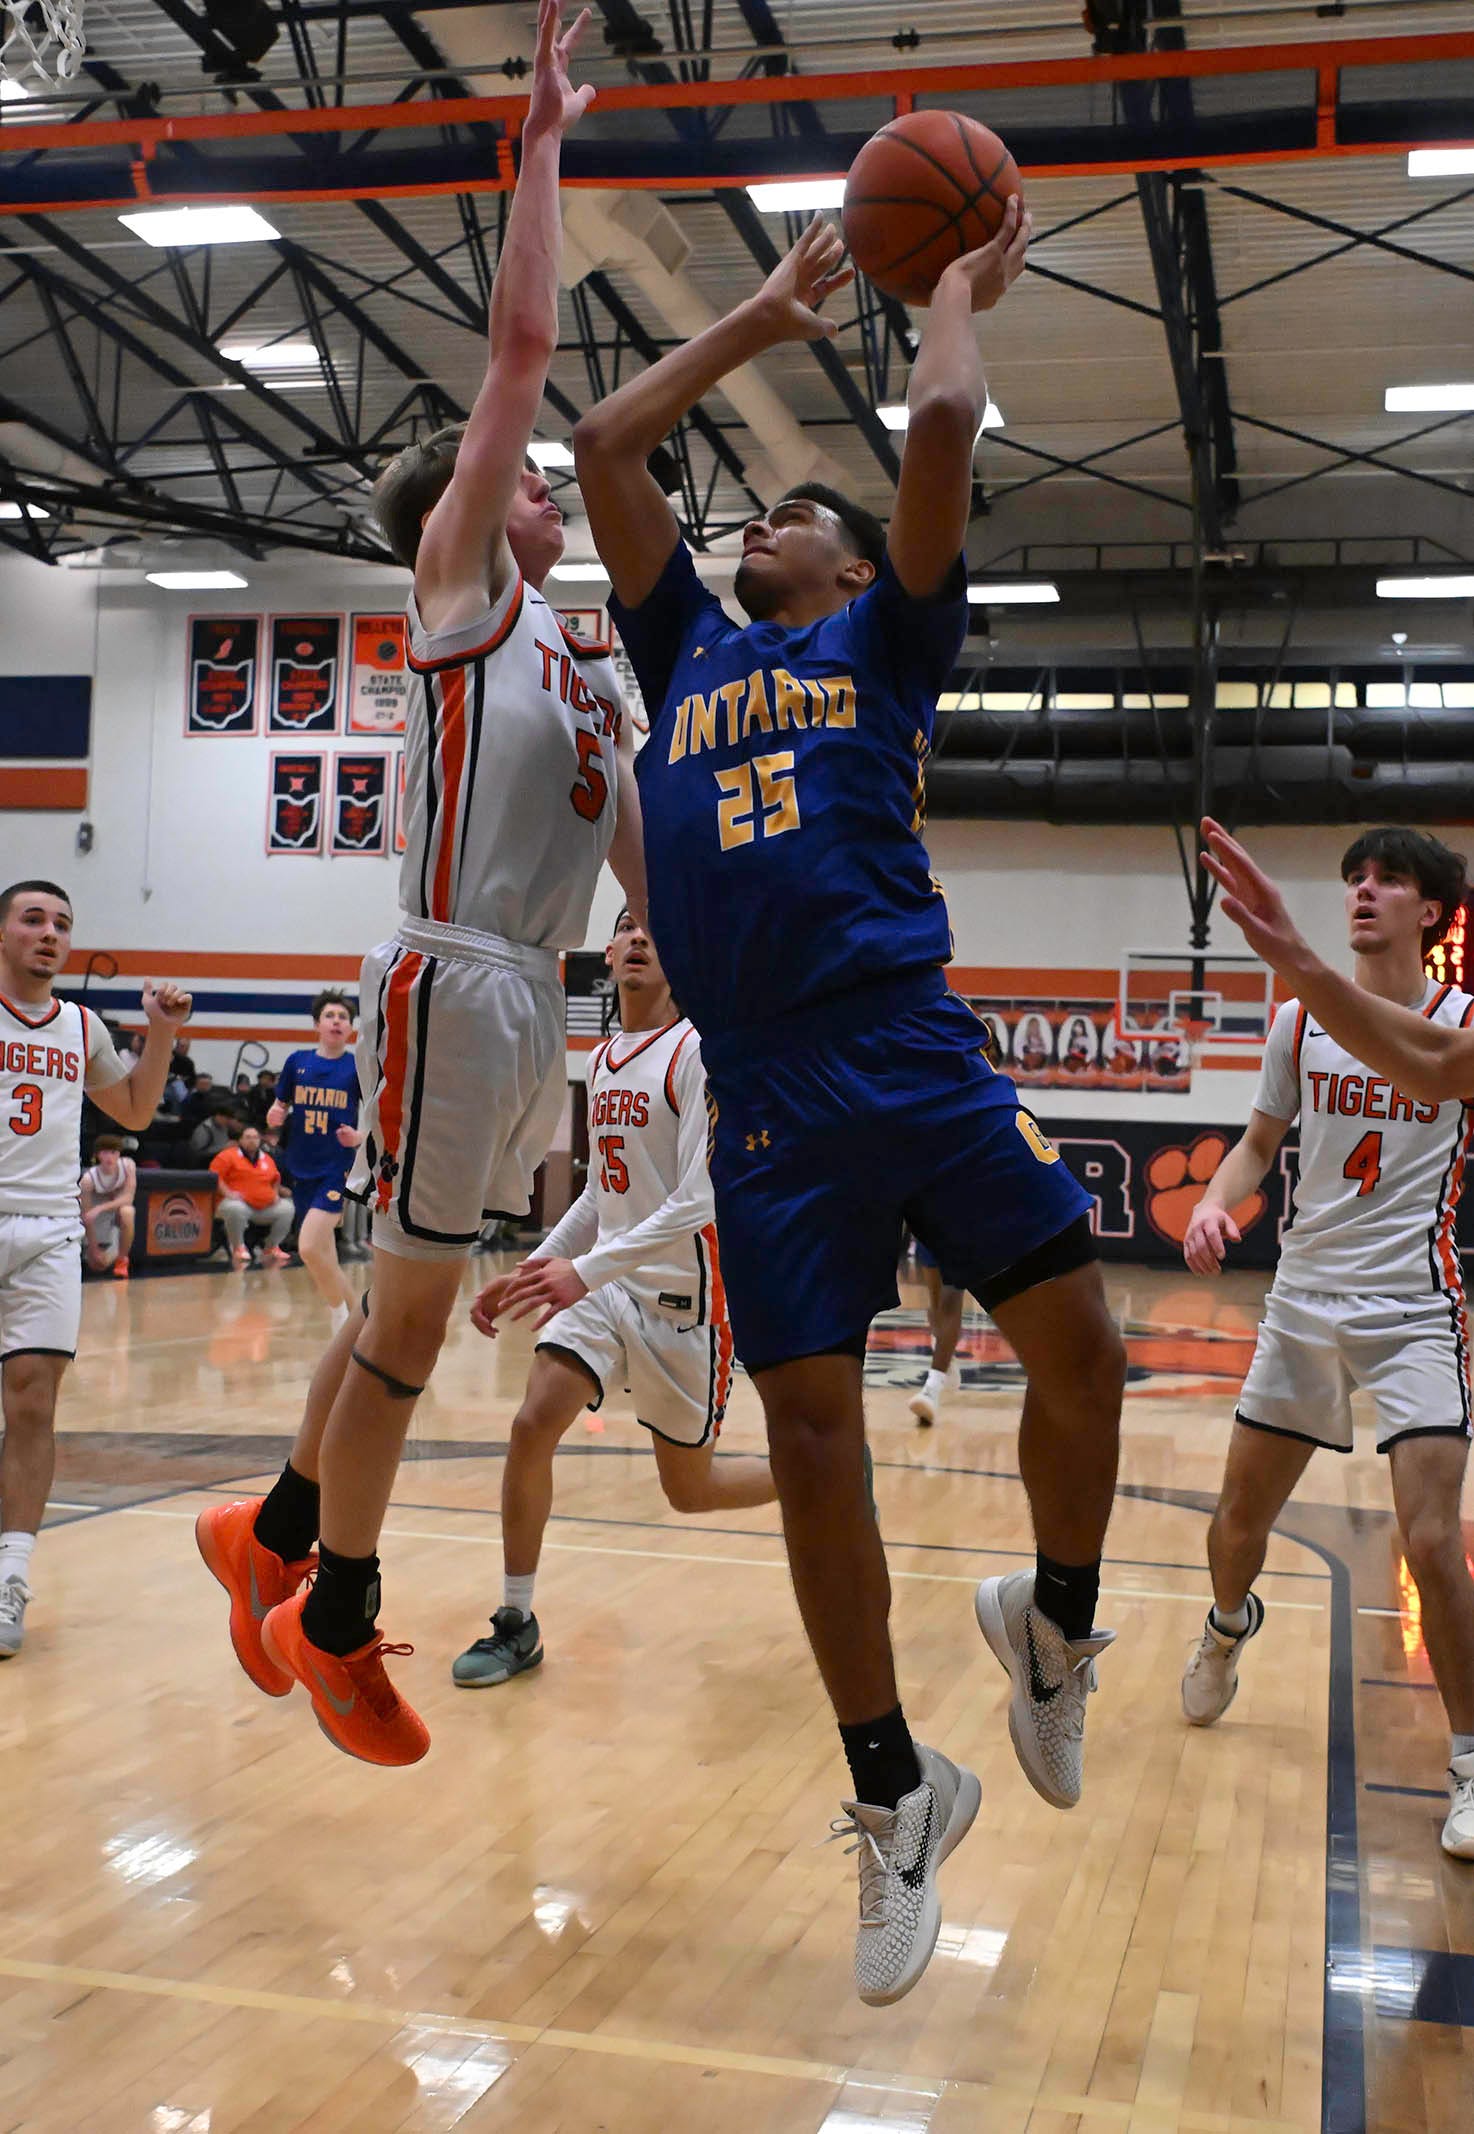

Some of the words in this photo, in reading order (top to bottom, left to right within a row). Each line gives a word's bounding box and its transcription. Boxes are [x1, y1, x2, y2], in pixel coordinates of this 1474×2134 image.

[668, 669, 856, 765] ONTARIO
[569, 727, 608, 824] 5
[713, 750, 800, 851] 25
[9, 1082, 44, 1136] 3
[294, 1085, 348, 1110] ONTARIO
[304, 1109, 329, 1135] 24
[1343, 1130, 1383, 1197] 4
